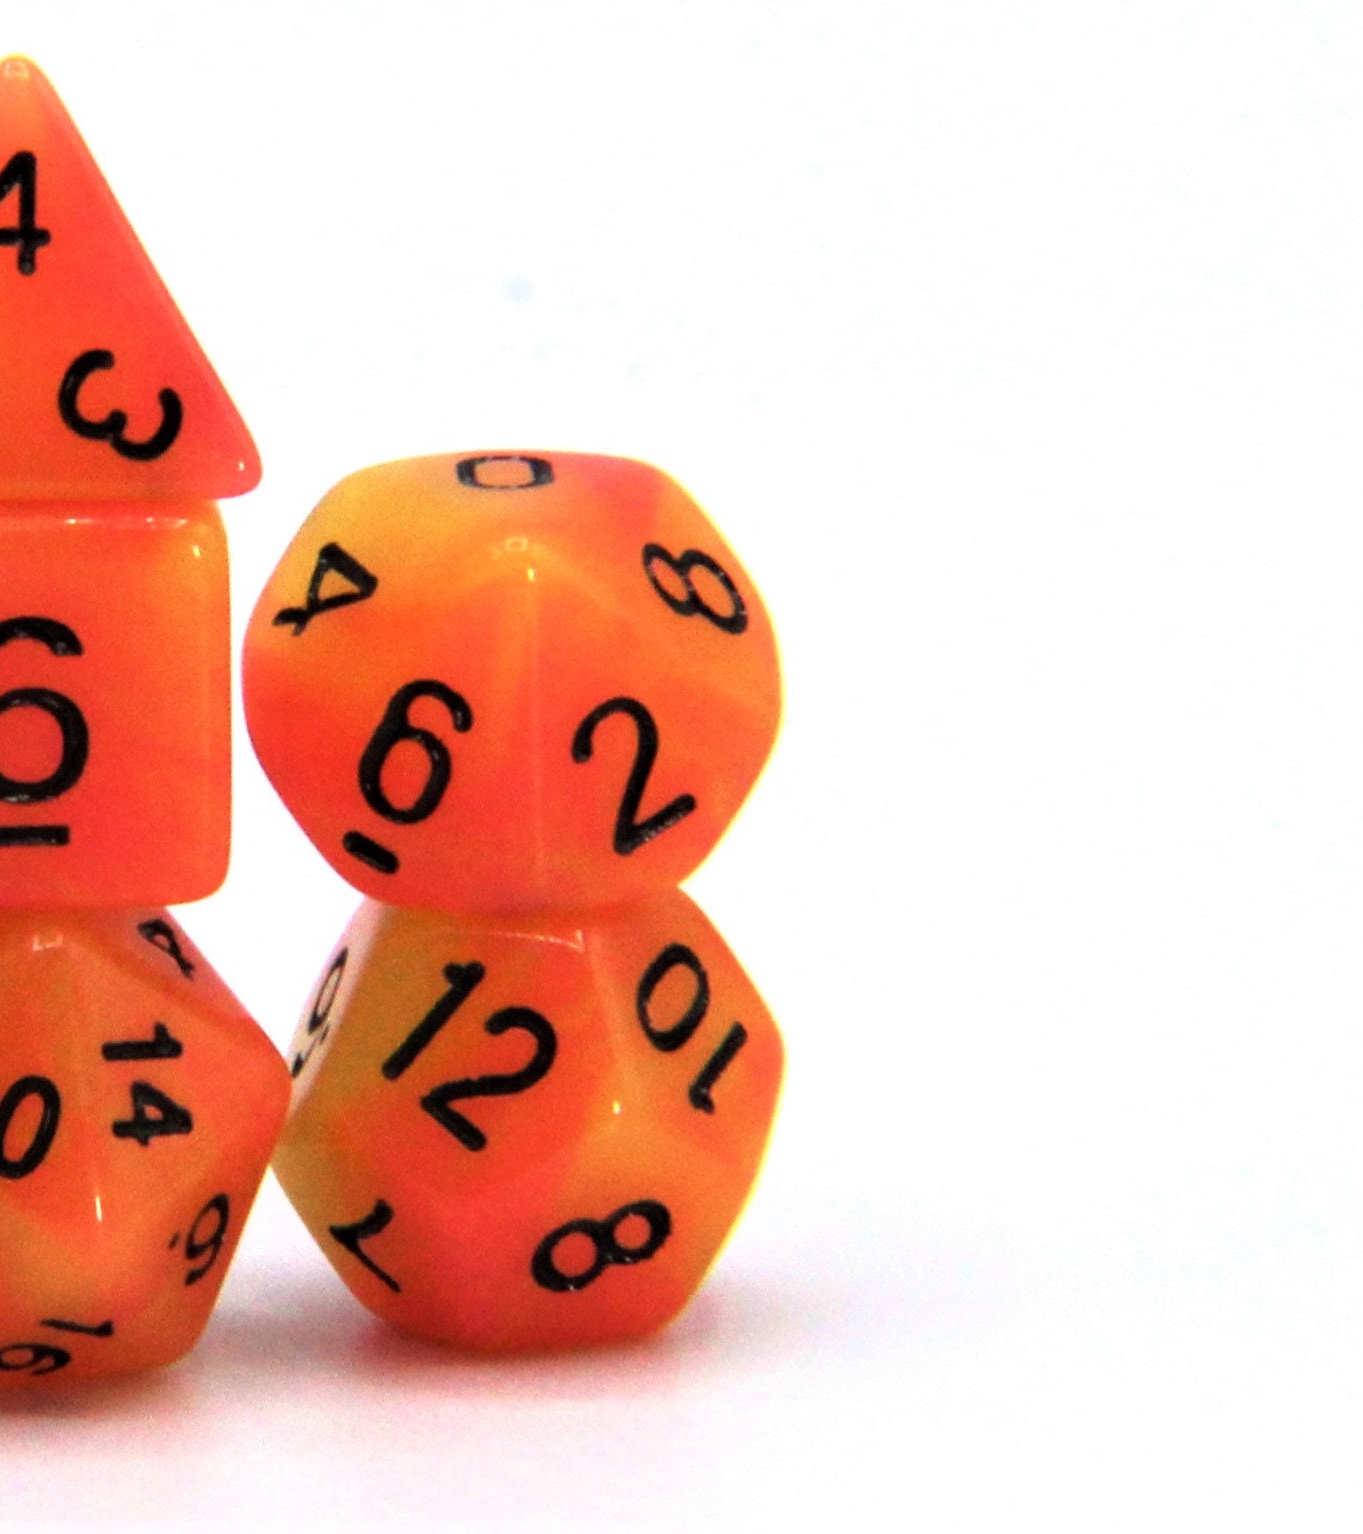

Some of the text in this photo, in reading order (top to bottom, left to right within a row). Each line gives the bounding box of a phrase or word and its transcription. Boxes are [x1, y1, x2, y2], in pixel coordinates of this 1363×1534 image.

[57, 349, 184, 462] 3
[274, 542, 378, 636] 4
[642, 542, 748, 635] 8
[342, 679, 473, 875] 6
[571, 697, 696, 856] 2
[101, 1023, 193, 1146] 14
[380, 960, 558, 1152] 12
[636, 942, 747, 1113] 10
[530, 1199, 672, 1293] 8
